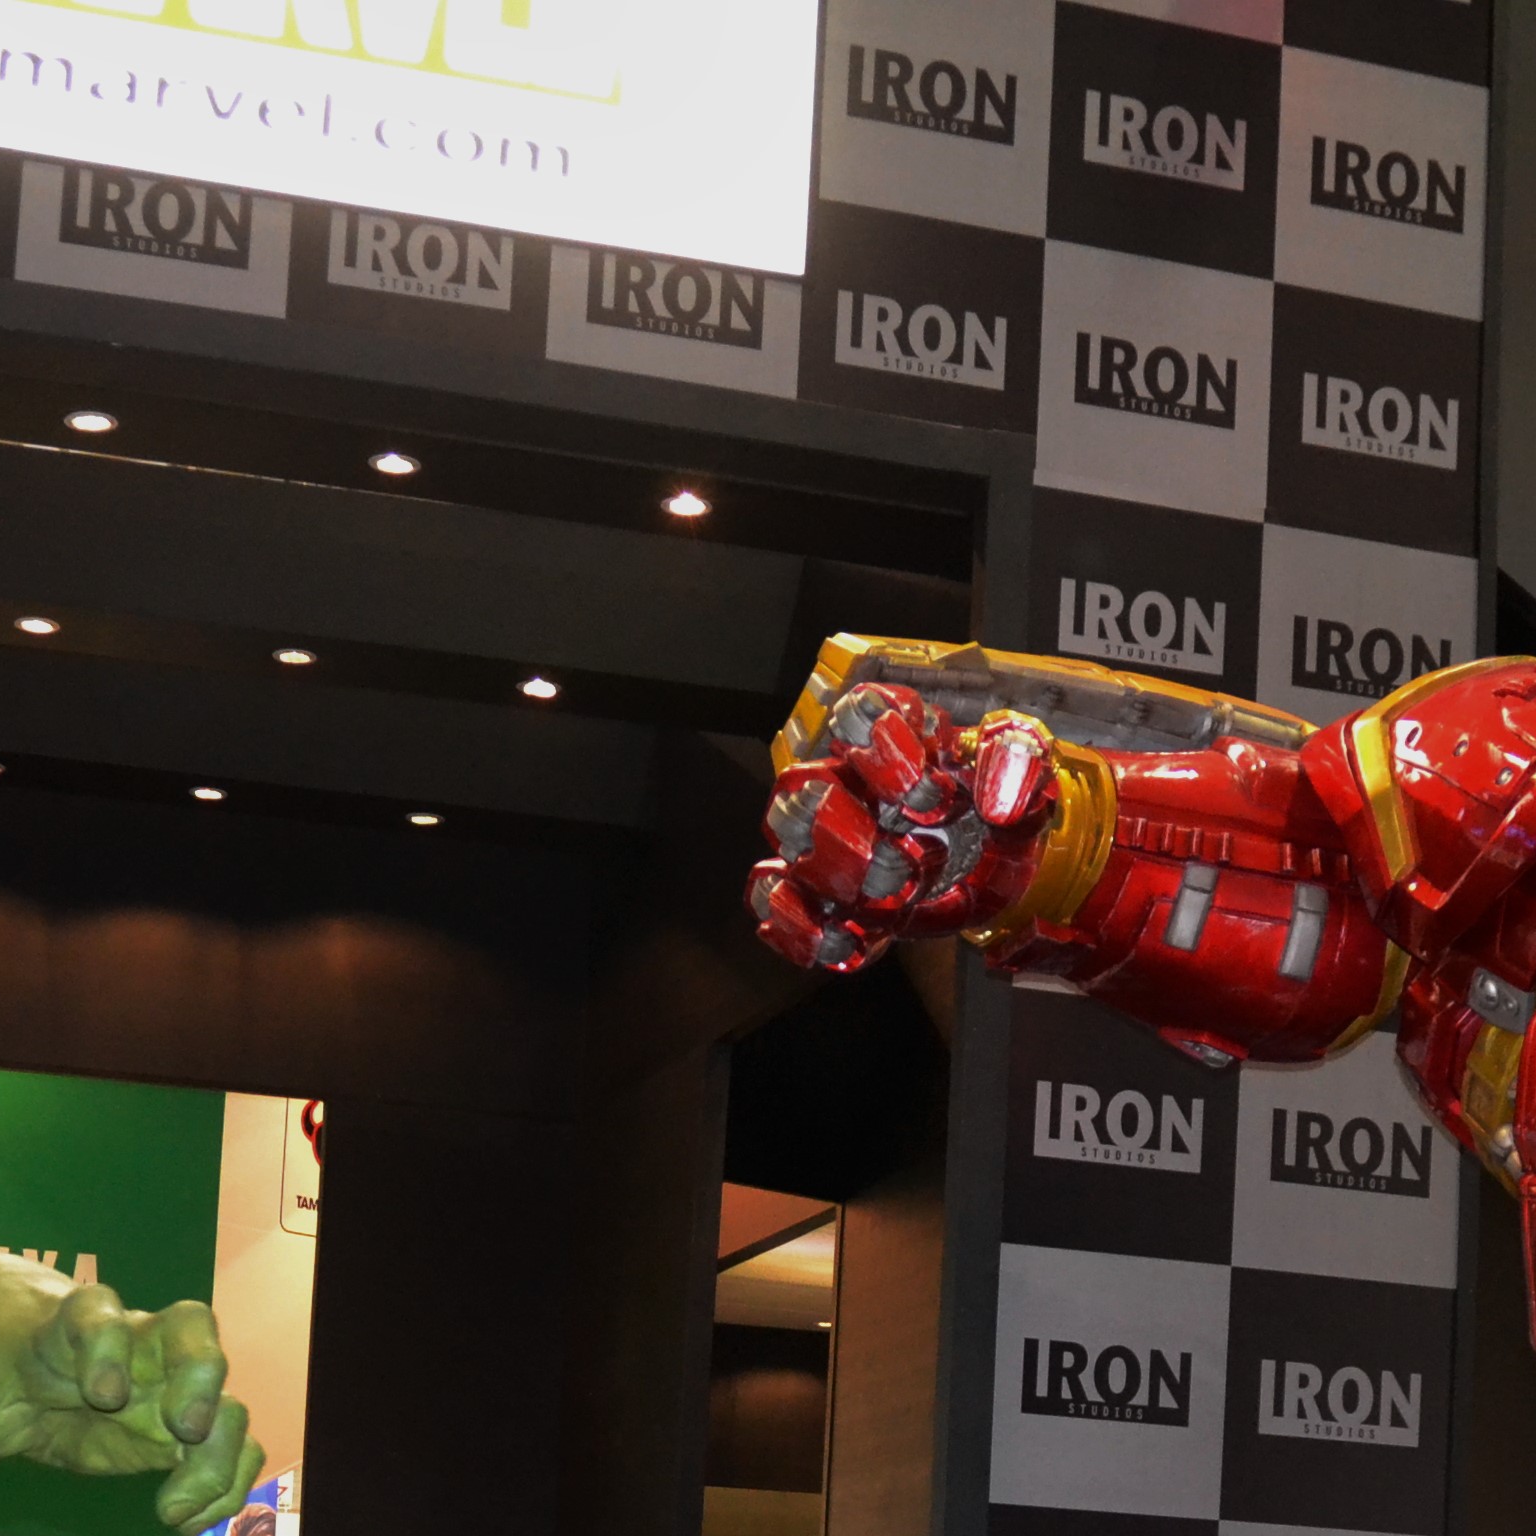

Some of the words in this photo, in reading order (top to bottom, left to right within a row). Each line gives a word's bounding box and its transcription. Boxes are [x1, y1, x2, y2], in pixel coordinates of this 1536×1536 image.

[0, 48, 572, 178] marvel.com
[847, 44, 1017, 131] IRON
[893, 110, 970, 135] STUDIOS
[1084, 89, 1247, 177] IRON
[1128, 155, 1202, 181] STUDIOS
[60, 166, 253, 255] IRON
[1310, 135, 1465, 220] IRON
[1352, 199, 1423, 224] STUDIOS
[111, 234, 199, 260] STUDIOS
[328, 208, 513, 296] IRON
[378, 276, 462, 301] STUDIOS
[587, 249, 764, 335] IRON
[634, 316, 715, 340] STUDIOS
[836, 289, 1007, 376] IRON
[882, 356, 960, 380] STUDIOS
[1075, 331, 1237, 416] IRON
[1119, 396, 1193, 420] STUDIOS
[1302, 372, 1459, 455] IRON
[1344, 437, 1416, 460] STUDIOS
[1058, 578, 1226, 661] IRON
[1103, 643, 1180, 666] STUDIOS
[1034, 1080, 1203, 1158] IRON
[1271, 1108, 1432, 1184] IRON
[1080, 1146, 1157, 1166] STUDIOS
[1314, 1171, 1387, 1191] STUDIOS
[1022, 1338, 1192, 1412] IRON
[1067, 1402, 1145, 1421] STUDIOS
[1259, 1360, 1422, 1433] IRON
[1302, 1423, 1377, 1441] STUDIOS
